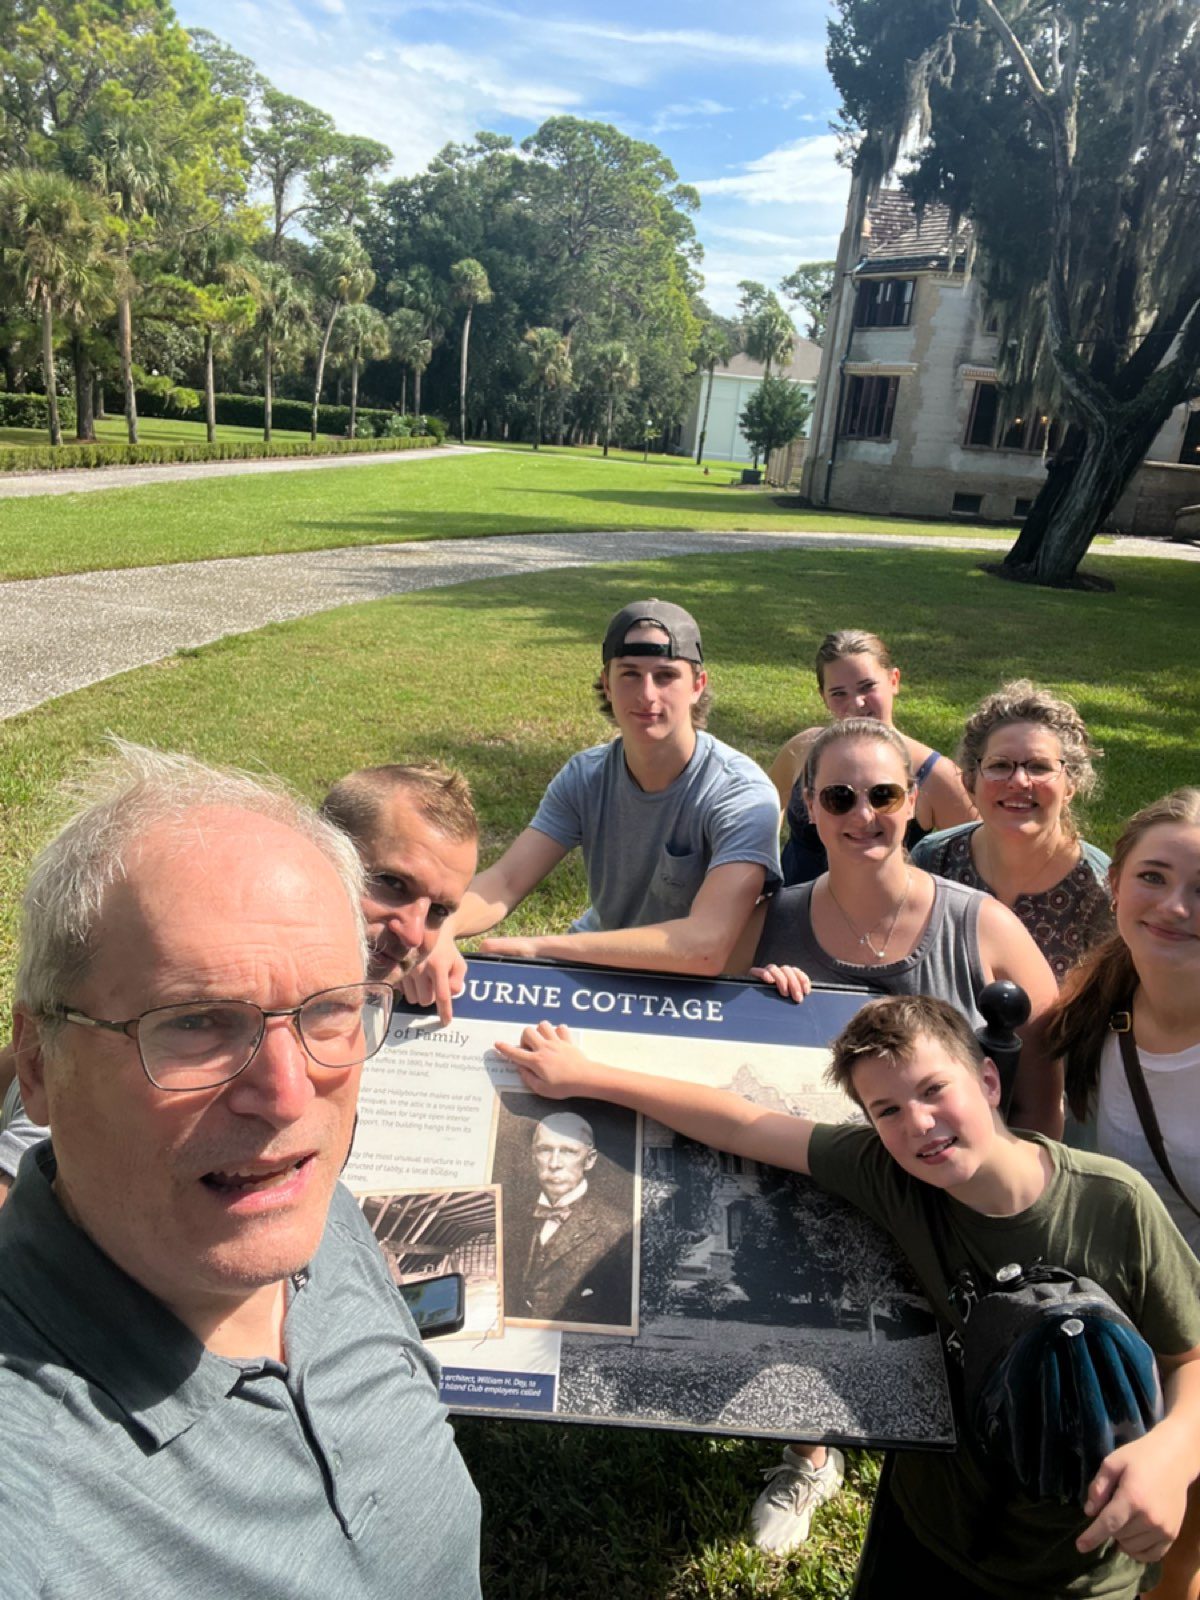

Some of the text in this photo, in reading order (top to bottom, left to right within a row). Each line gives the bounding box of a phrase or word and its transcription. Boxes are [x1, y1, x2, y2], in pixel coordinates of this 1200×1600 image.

[571, 988, 724, 1022] COTTAGE
[394, 1027, 470, 1048] of Family
[477, 1375, 504, 1385] William
[445, 1382, 467, 1392] Island
[467, 1383, 484, 1393] Club
[484, 1386, 520, 1397] employees
